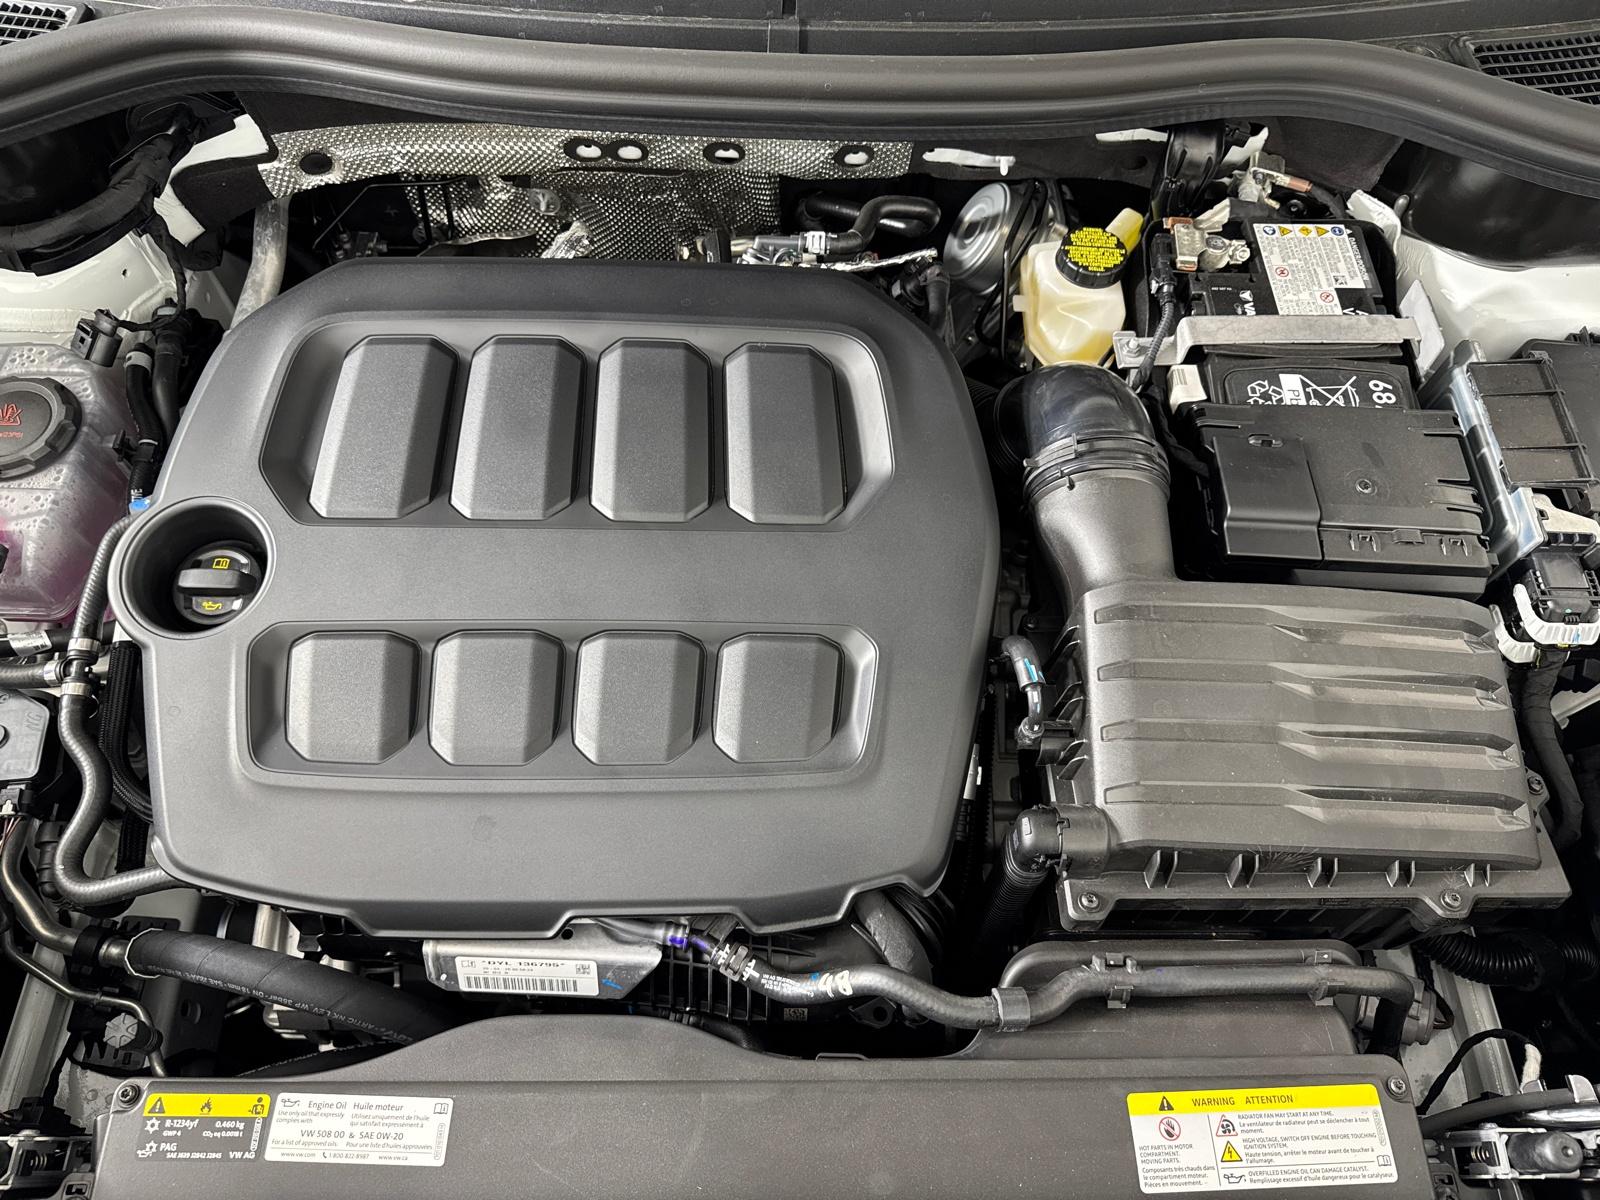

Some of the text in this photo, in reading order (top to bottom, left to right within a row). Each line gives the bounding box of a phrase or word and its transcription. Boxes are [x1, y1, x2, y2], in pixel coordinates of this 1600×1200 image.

[1369, 380, 1396, 408] 68
[308, 1101, 334, 1110] Engine
[336, 1101, 347, 1109] Oil
[353, 1102, 373, 1111] Huile
[1192, 1094, 1294, 1106] WARNING ATTENTION
[165, 1119, 246, 1131] R-1234yf 0.460 kg
[300, 1129, 404, 1141] VW 508 00 & SAE 0W-20
[159, 1143, 177, 1151] PAG
